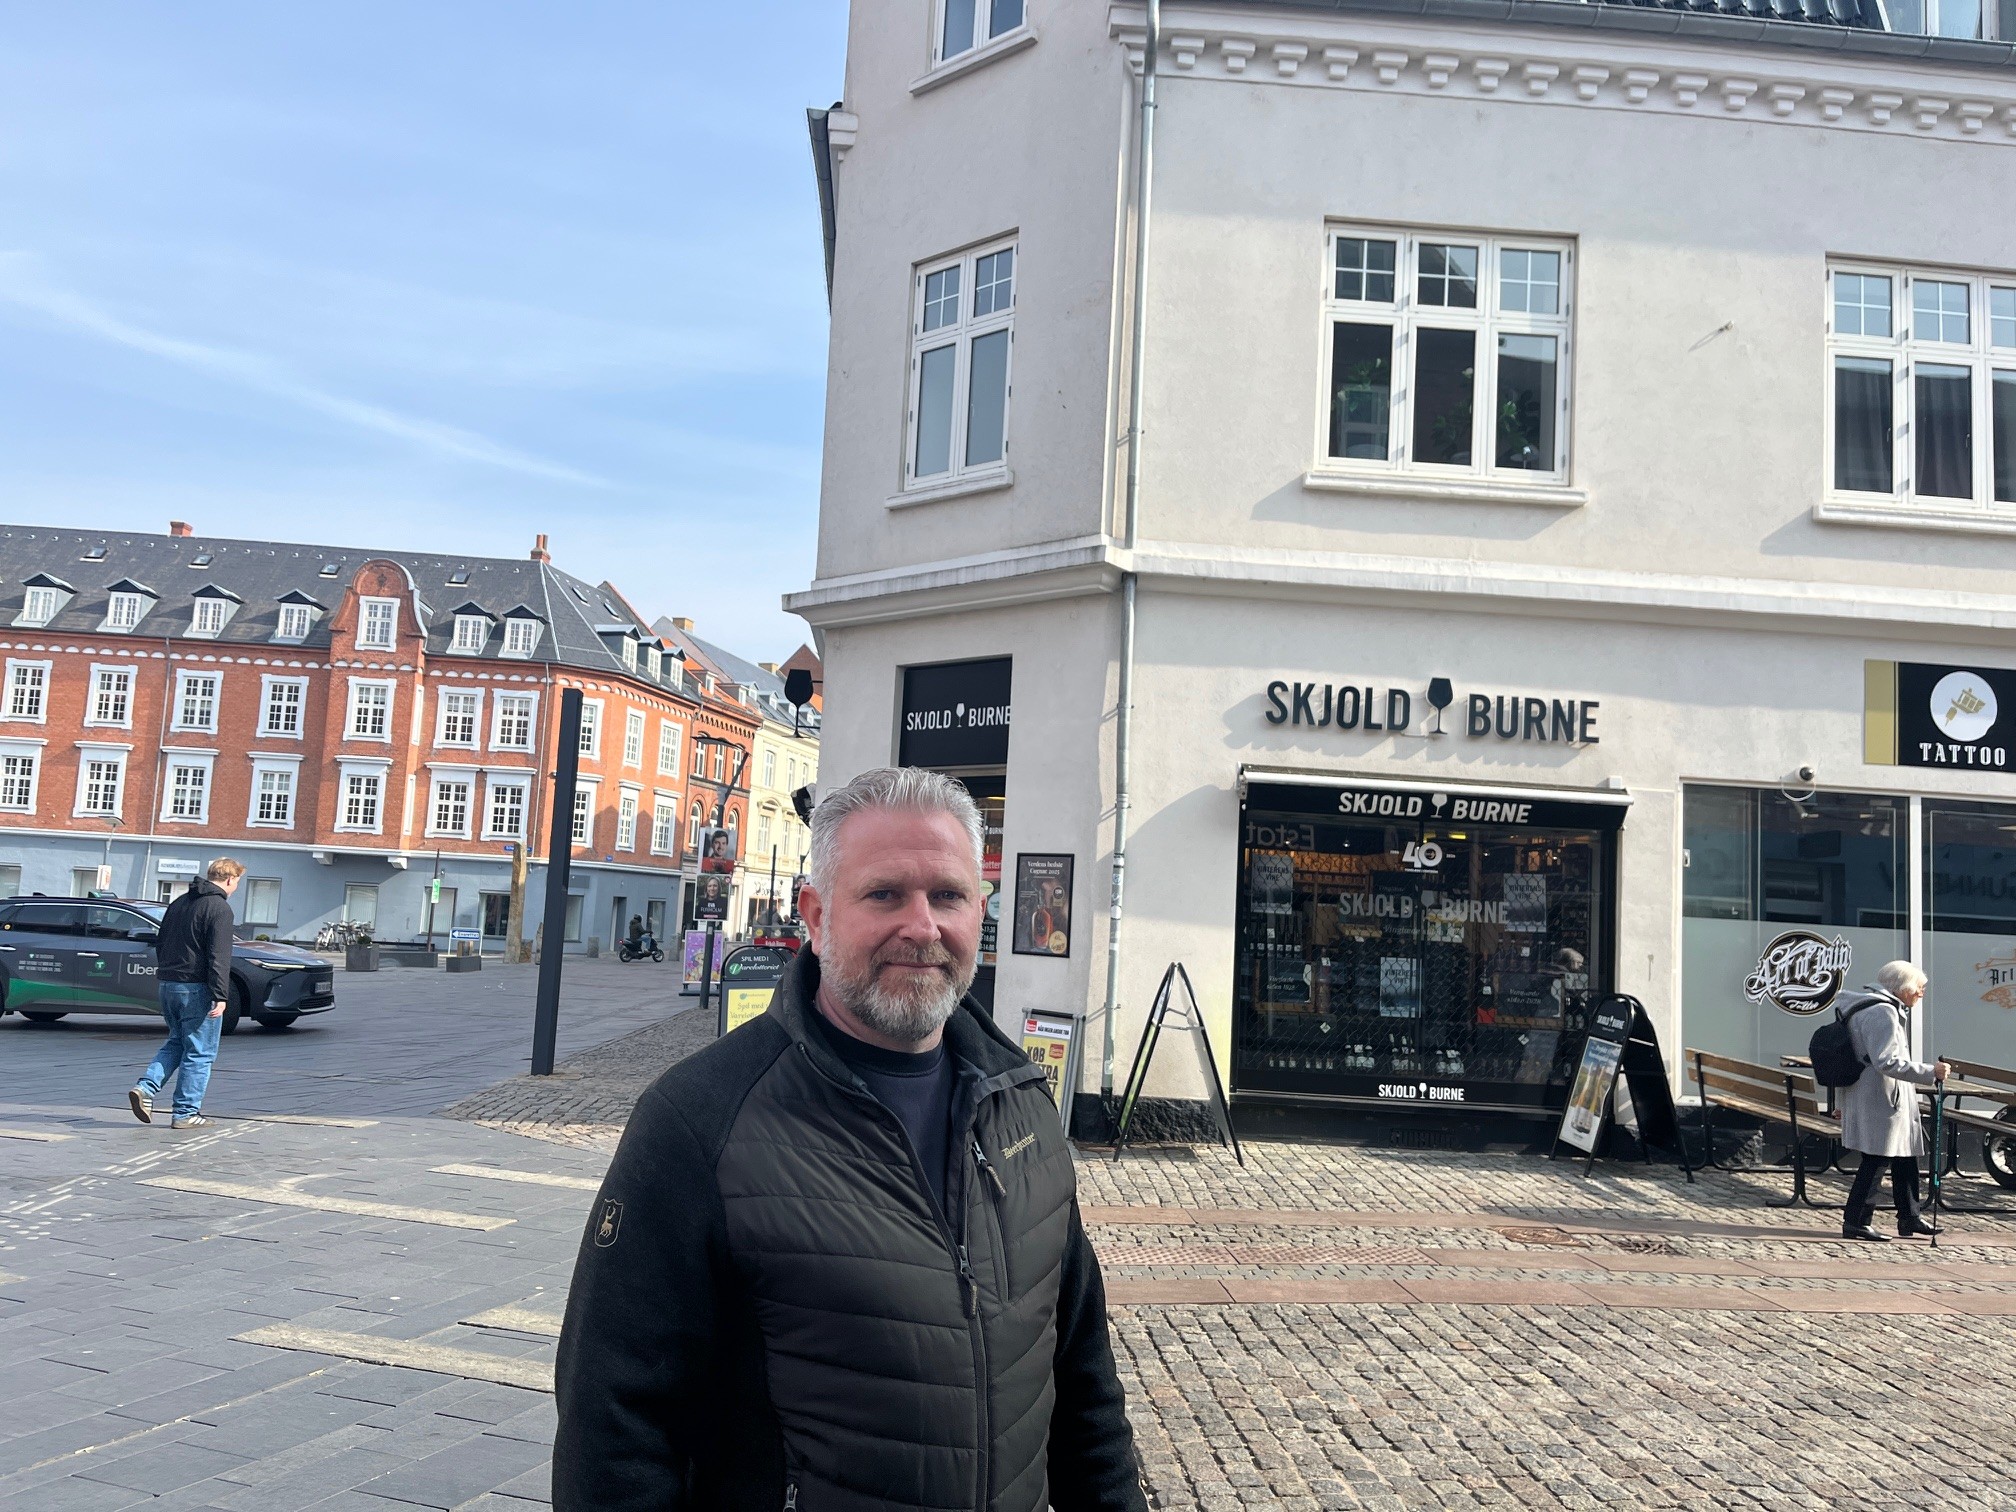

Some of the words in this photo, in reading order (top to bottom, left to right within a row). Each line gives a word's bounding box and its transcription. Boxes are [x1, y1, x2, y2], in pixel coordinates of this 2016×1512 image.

[906, 709, 952, 731] SKJOLD
[968, 705, 1011, 727] BURNE
[1265, 680, 1410, 732] SKJOLD
[1467, 693, 1600, 744] BURNE
[1919, 742, 2006, 767] TATTOO
[1338, 791, 1423, 818] SKJOLD
[1452, 799, 1532, 824] BURNE
[1402, 841, 1443, 868] 40
[1339, 892, 1413, 919] SKJOLD
[1441, 899, 1510, 925] BURNE
[127, 963, 159, 975] Uber
[1026, 1046, 1045, 1063] KØB
[1378, 1084, 1416, 1098] SKJOLD
[1429, 1087, 1465, 1101] BURNE
